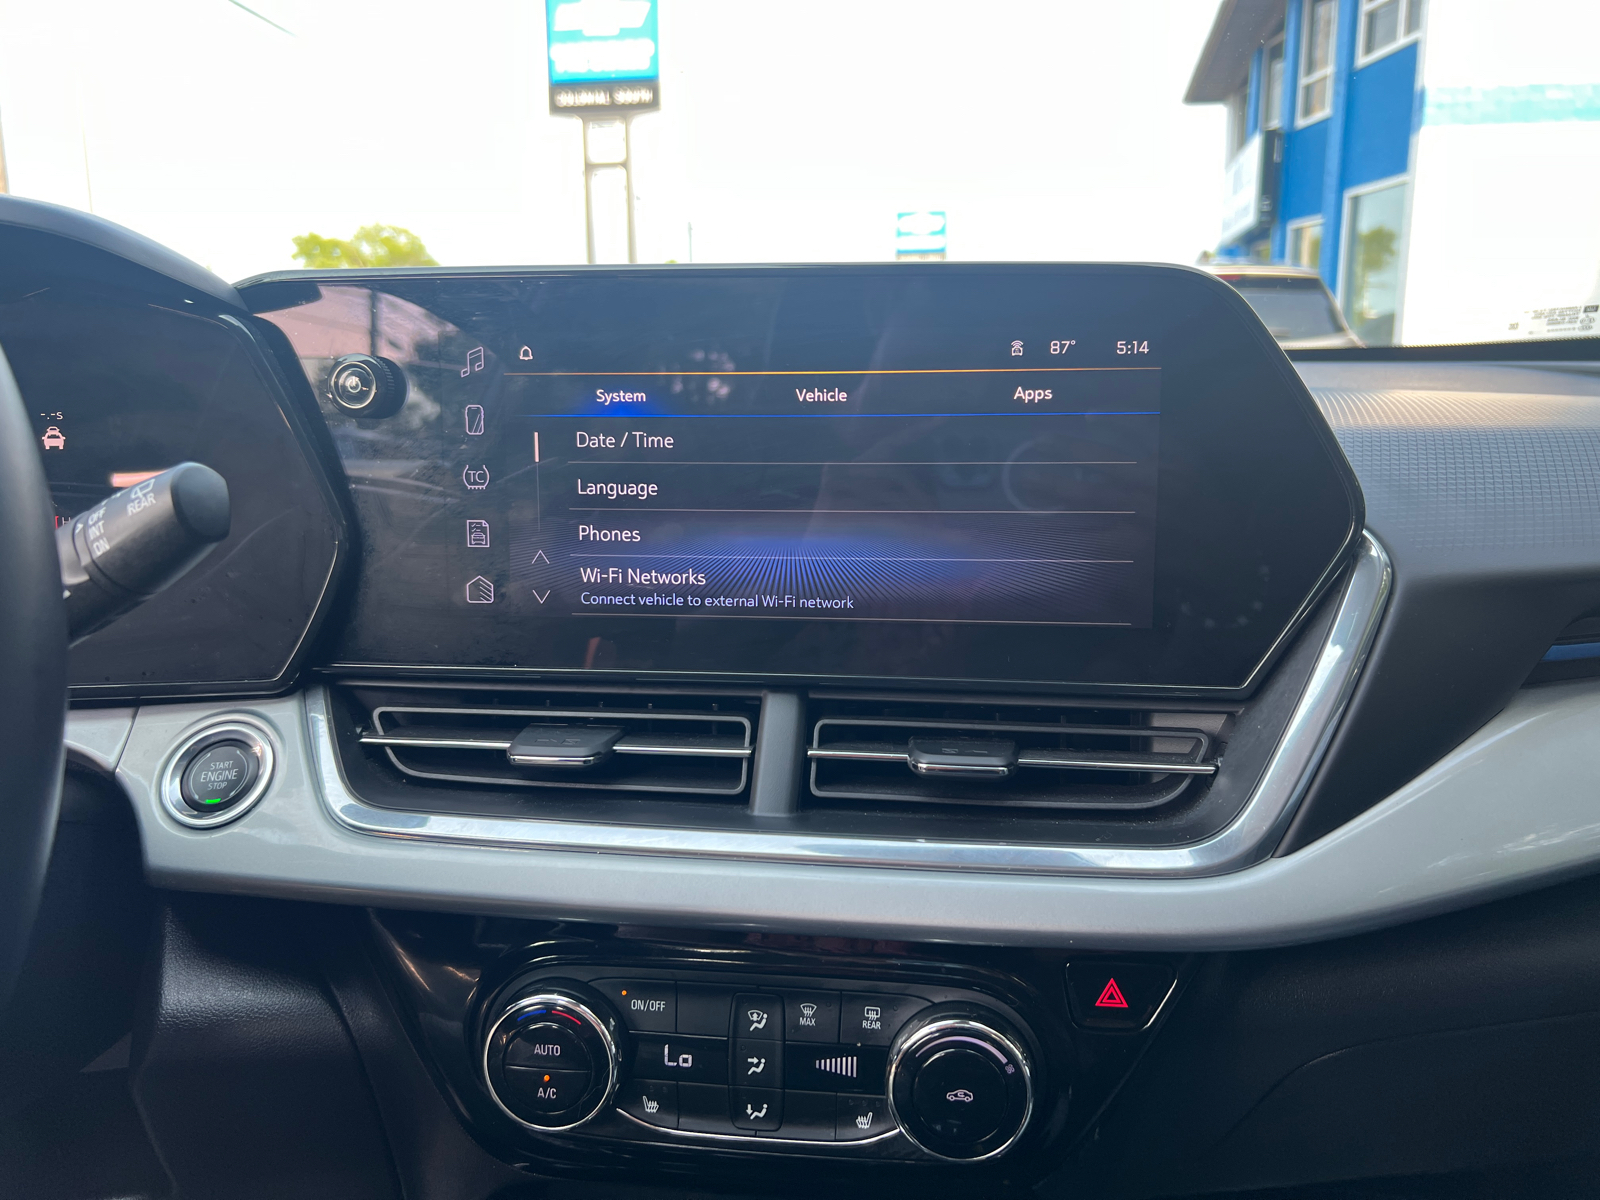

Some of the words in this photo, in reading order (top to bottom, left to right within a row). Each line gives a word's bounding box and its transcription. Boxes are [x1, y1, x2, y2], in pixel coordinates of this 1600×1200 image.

[1116, 340, 1149, 354] 5:14
[596, 389, 646, 405] System
[796, 388, 848, 402] Vehicle
[1013, 386, 1053, 403] Apps
[576, 431, 616, 448] Date
[620, 431, 629, 448] /
[632, 431, 674, 448] Time
[467, 470, 485, 483] TC
[577, 478, 658, 500] Language
[127, 493, 156, 516] REAR
[88, 506, 107, 525] OFF
[88, 520, 105, 540] INT
[578, 524, 641, 542] Phones
[93, 537, 111, 556] ON
[580, 567, 623, 584] Wi-Fi
[627, 567, 706, 585] Networks
[580, 592, 636, 605] Connect
[638, 593, 684, 606] vehicle
[687, 595, 702, 606] to
[704, 594, 759, 607] external
[761, 595, 796, 608] Wi-Fi
[799, 595, 854, 609] network
[210, 761, 234, 770] START
[200, 769, 239, 782] ENGINE
[208, 782, 228, 790] STOP
[630, 999, 666, 1012] ON/OFF
[799, 1016, 816, 1027] MAX
[862, 1020, 881, 1030] REAR
[533, 1043, 561, 1056] AUTO
[536, 1087, 557, 1099] A/C
